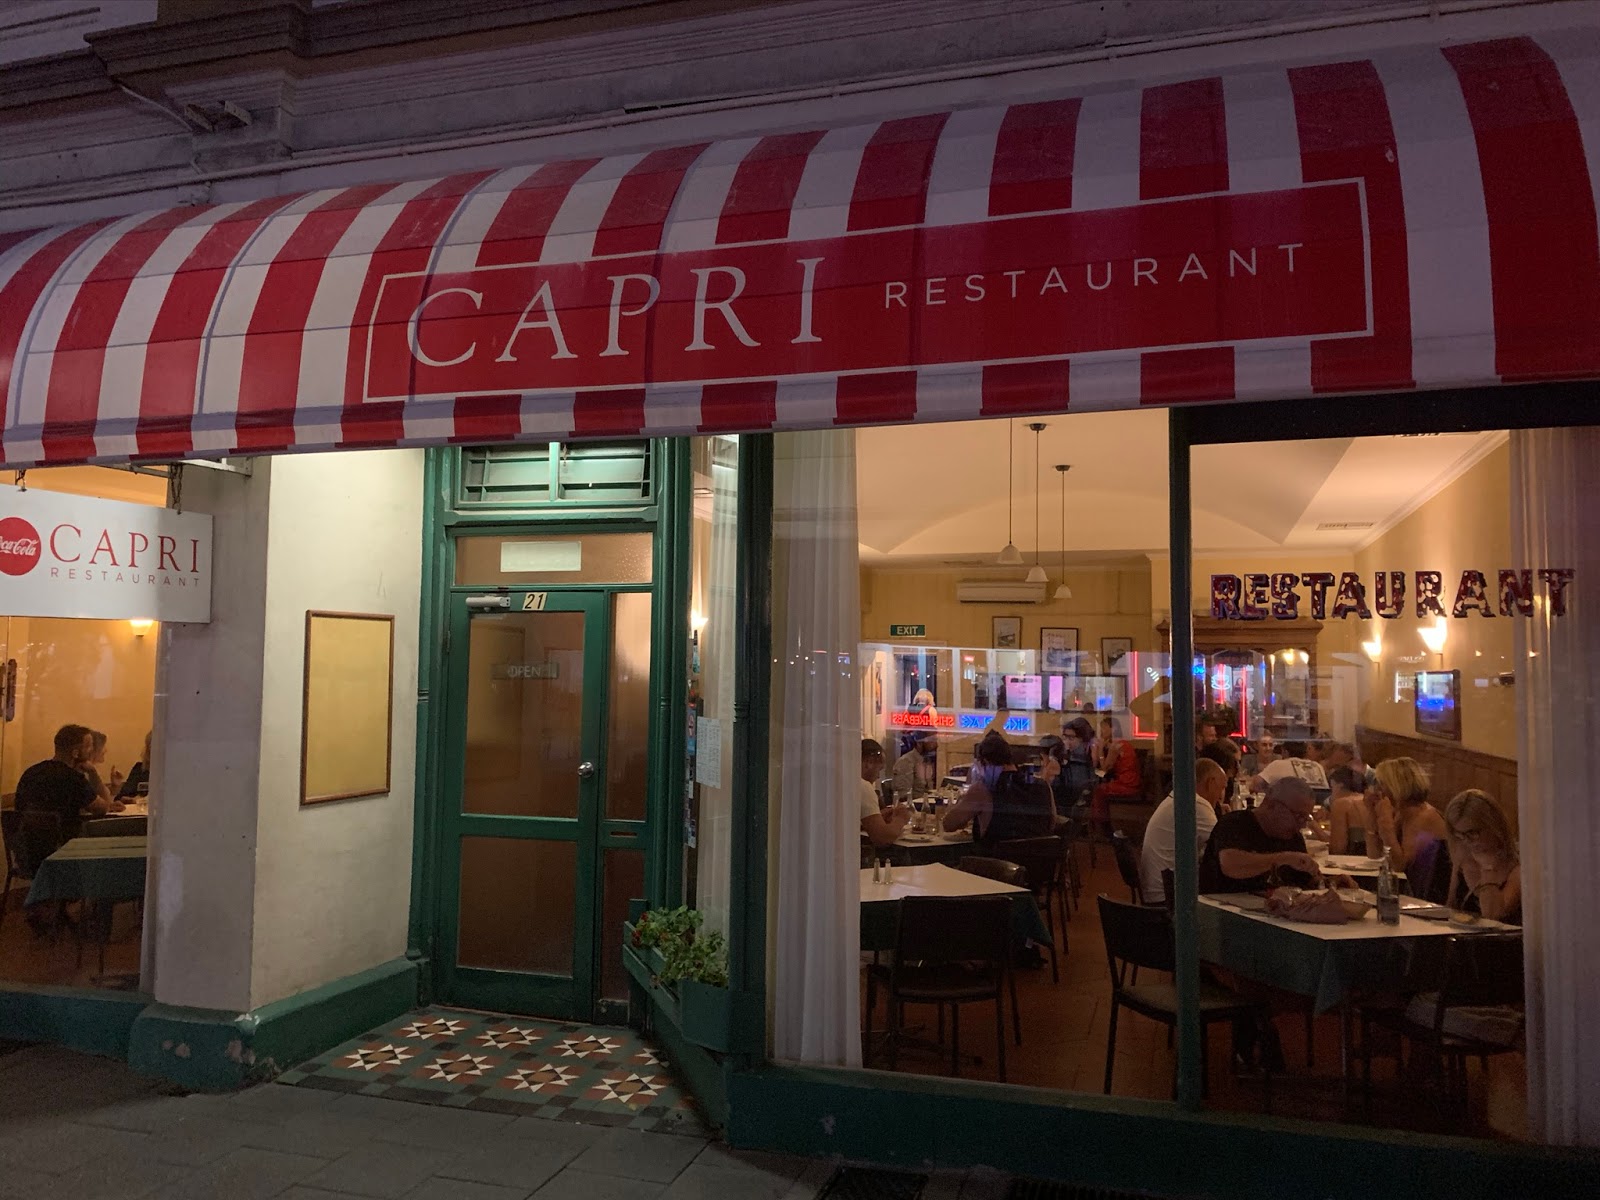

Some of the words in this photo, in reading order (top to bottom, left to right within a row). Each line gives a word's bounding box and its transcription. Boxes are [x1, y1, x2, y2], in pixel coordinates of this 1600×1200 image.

[406, 256, 826, 368] CAPRI
[884, 242, 1304, 309] RESTAURANT
[49, 523, 200, 574] CAPRI
[50, 567, 200, 587] RESTAURANT
[525, 594, 544, 609] 21
[1209, 568, 1576, 620] RESTAURANT
[896, 626, 918, 635] EXIT
[507, 665, 541, 678] OPEN
